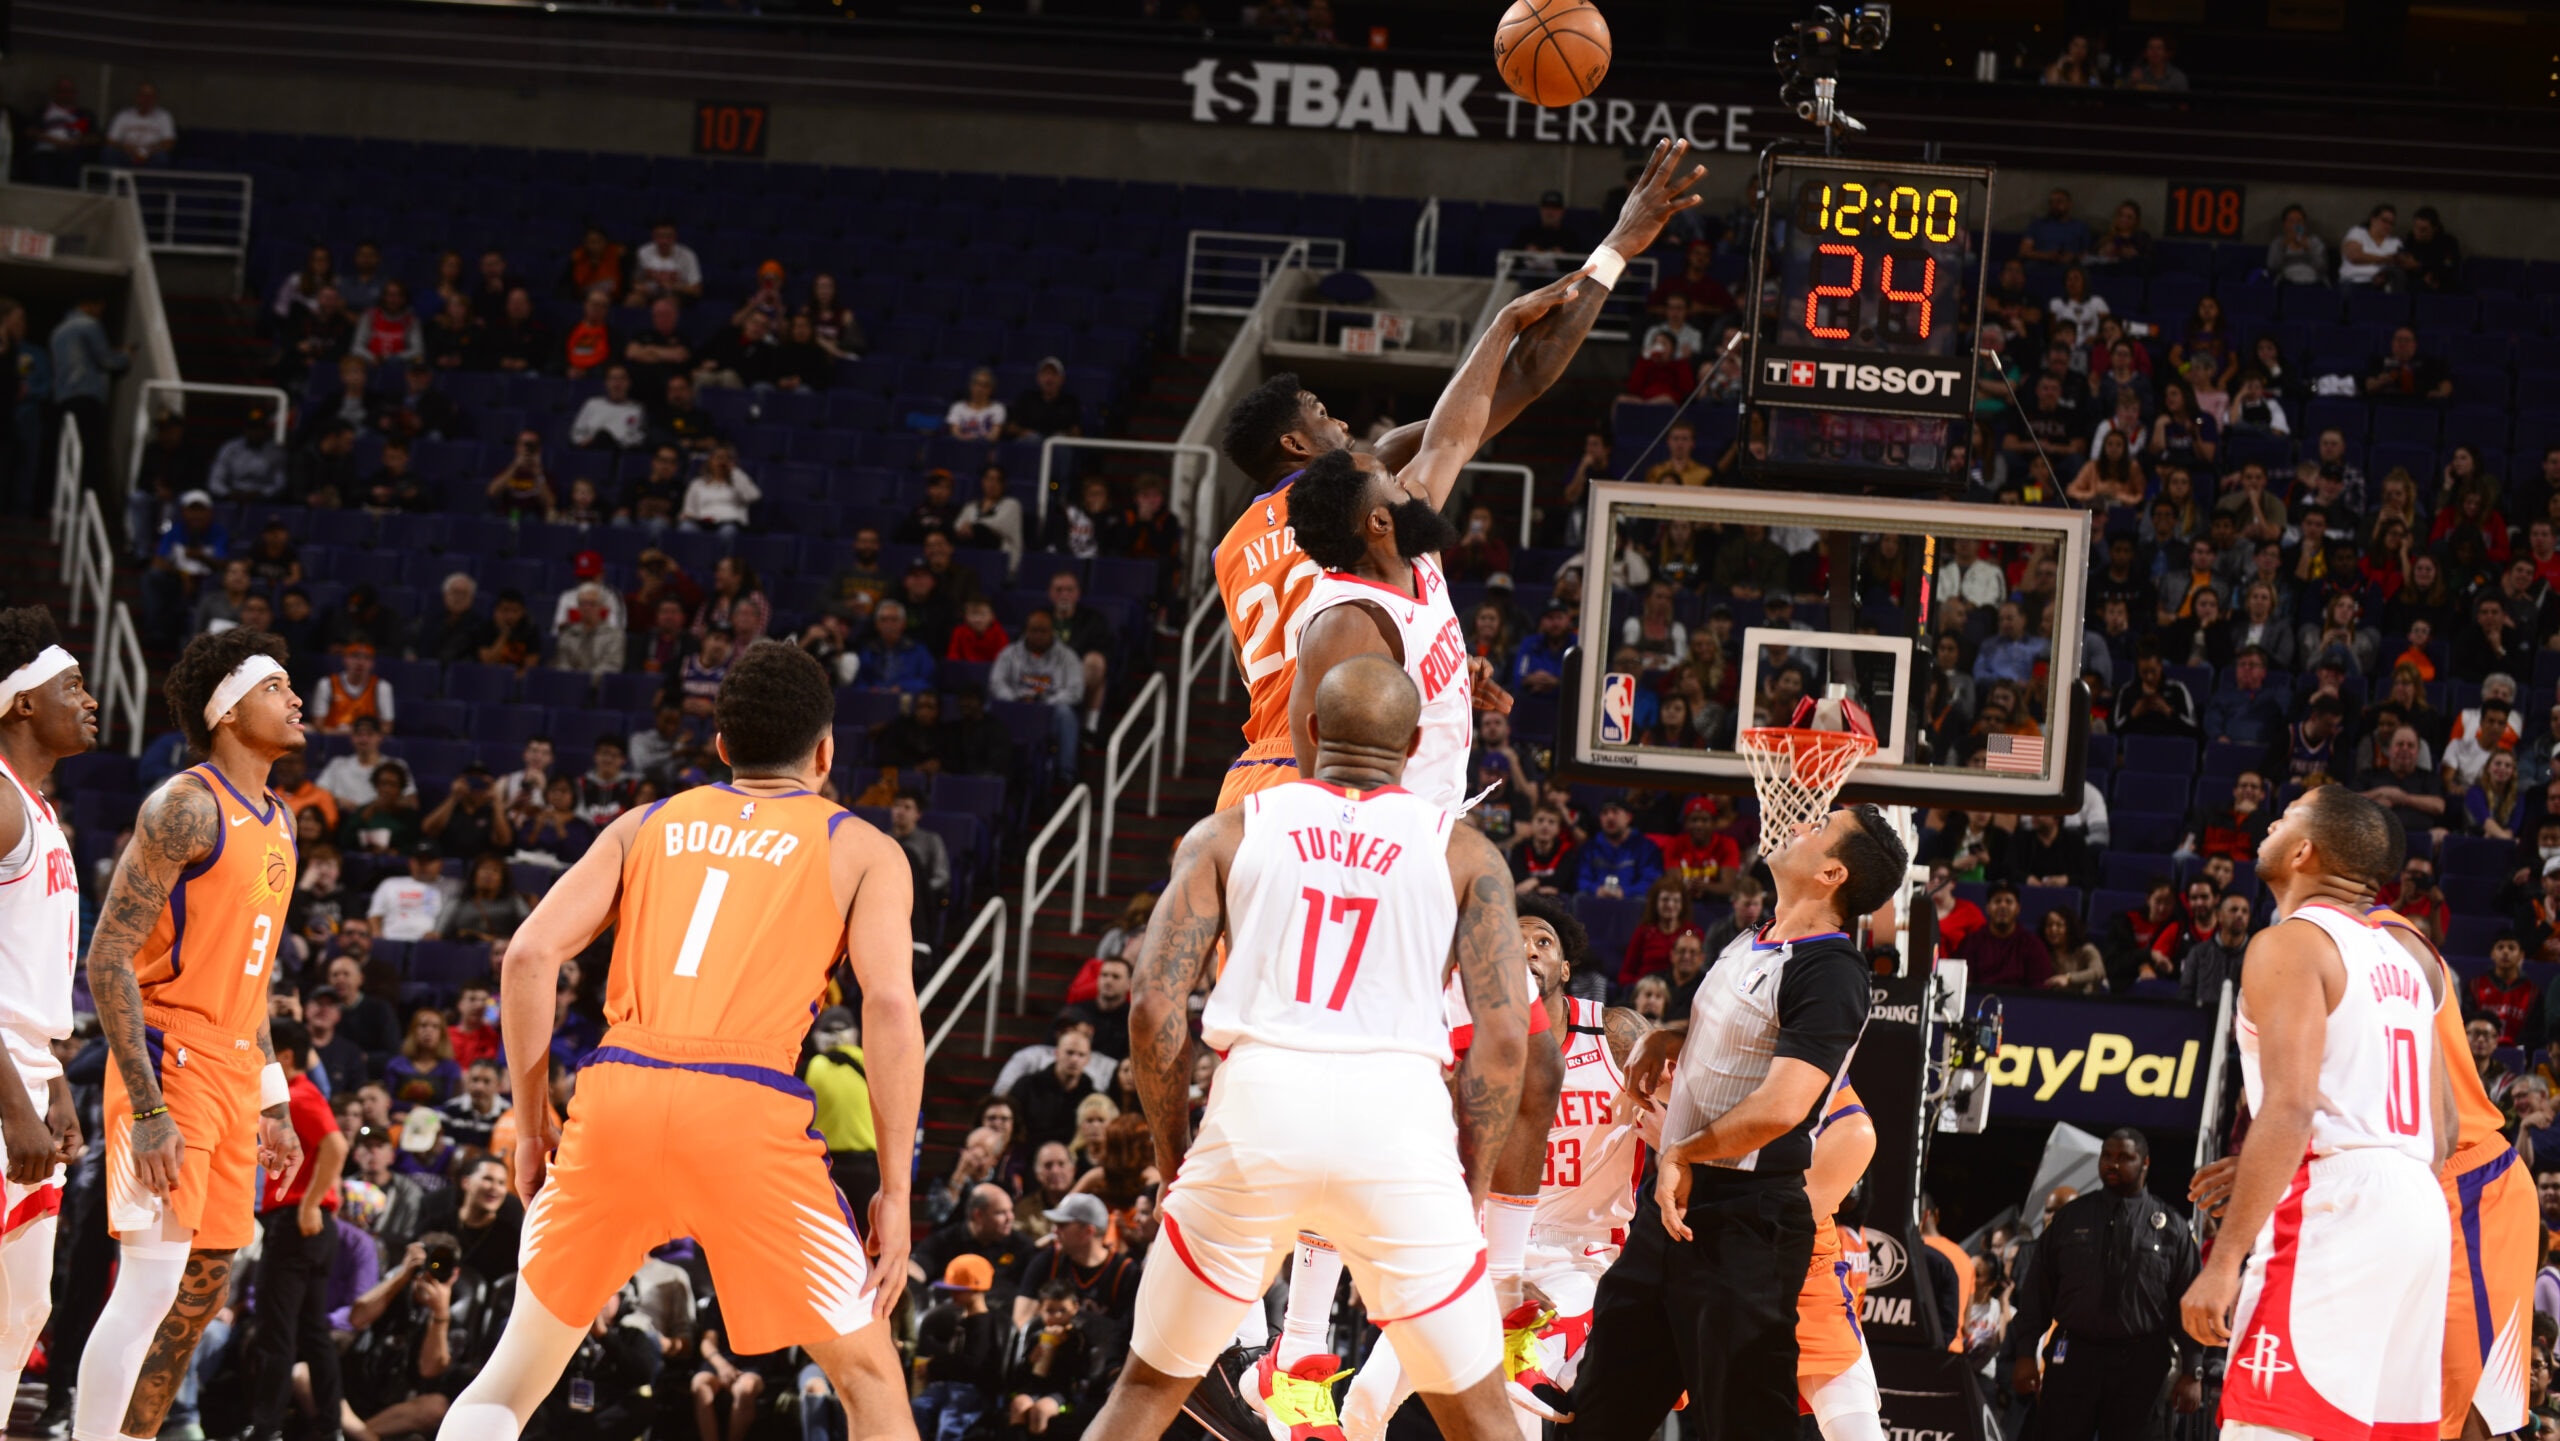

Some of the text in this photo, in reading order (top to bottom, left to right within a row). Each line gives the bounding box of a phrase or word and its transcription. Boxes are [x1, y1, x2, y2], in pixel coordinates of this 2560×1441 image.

[701, 106, 763, 152] 107
[1496, 93, 1753, 151] TERRACE
[1820, 183, 1957, 243] 12:00
[2173, 188, 2239, 235] 108
[1805, 244, 1935, 339] 24
[1819, 363, 1961, 397] TISSOT
[1243, 526, 1303, 577] AYTO
[665, 821, 799, 867] BOOKER
[1288, 827, 1402, 876] TUCKER
[245, 914, 271, 976] 3
[673, 866, 730, 978] 1
[1295, 886, 1378, 1012] 17
[2370, 962, 2420, 1009] GORDON
[1974, 1032, 2200, 1101] ayPal
[2385, 1025, 2420, 1136] 10
